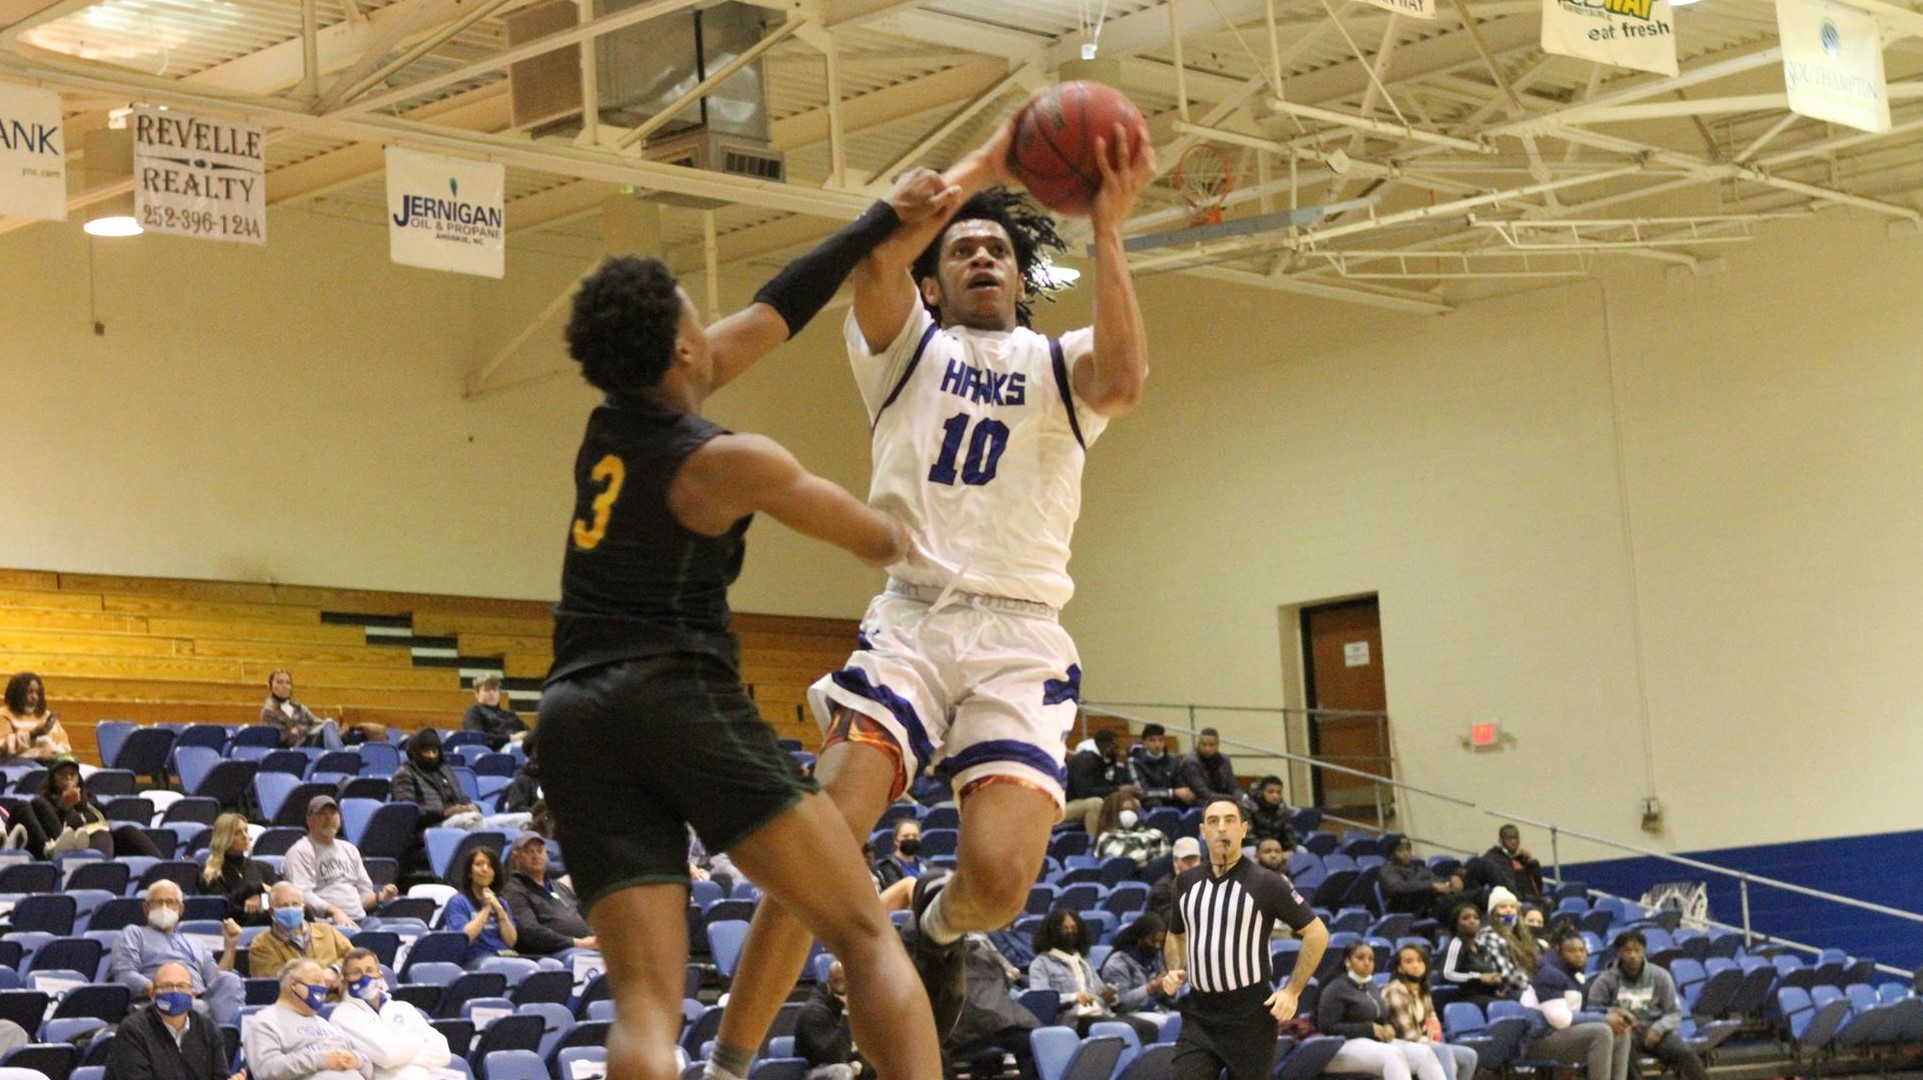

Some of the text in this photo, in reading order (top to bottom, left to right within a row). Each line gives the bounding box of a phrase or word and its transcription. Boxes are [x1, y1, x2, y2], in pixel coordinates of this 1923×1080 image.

[1587, 20, 1671, 41] eat fresh
[137, 114, 261, 159] REVELLE
[143, 167, 255, 202] REALTY
[393, 195, 502, 228] JERNIGAN
[411, 218, 501, 240] OIL & PROPANE
[928, 412, 1010, 486] 10
[573, 455, 625, 549] 3
